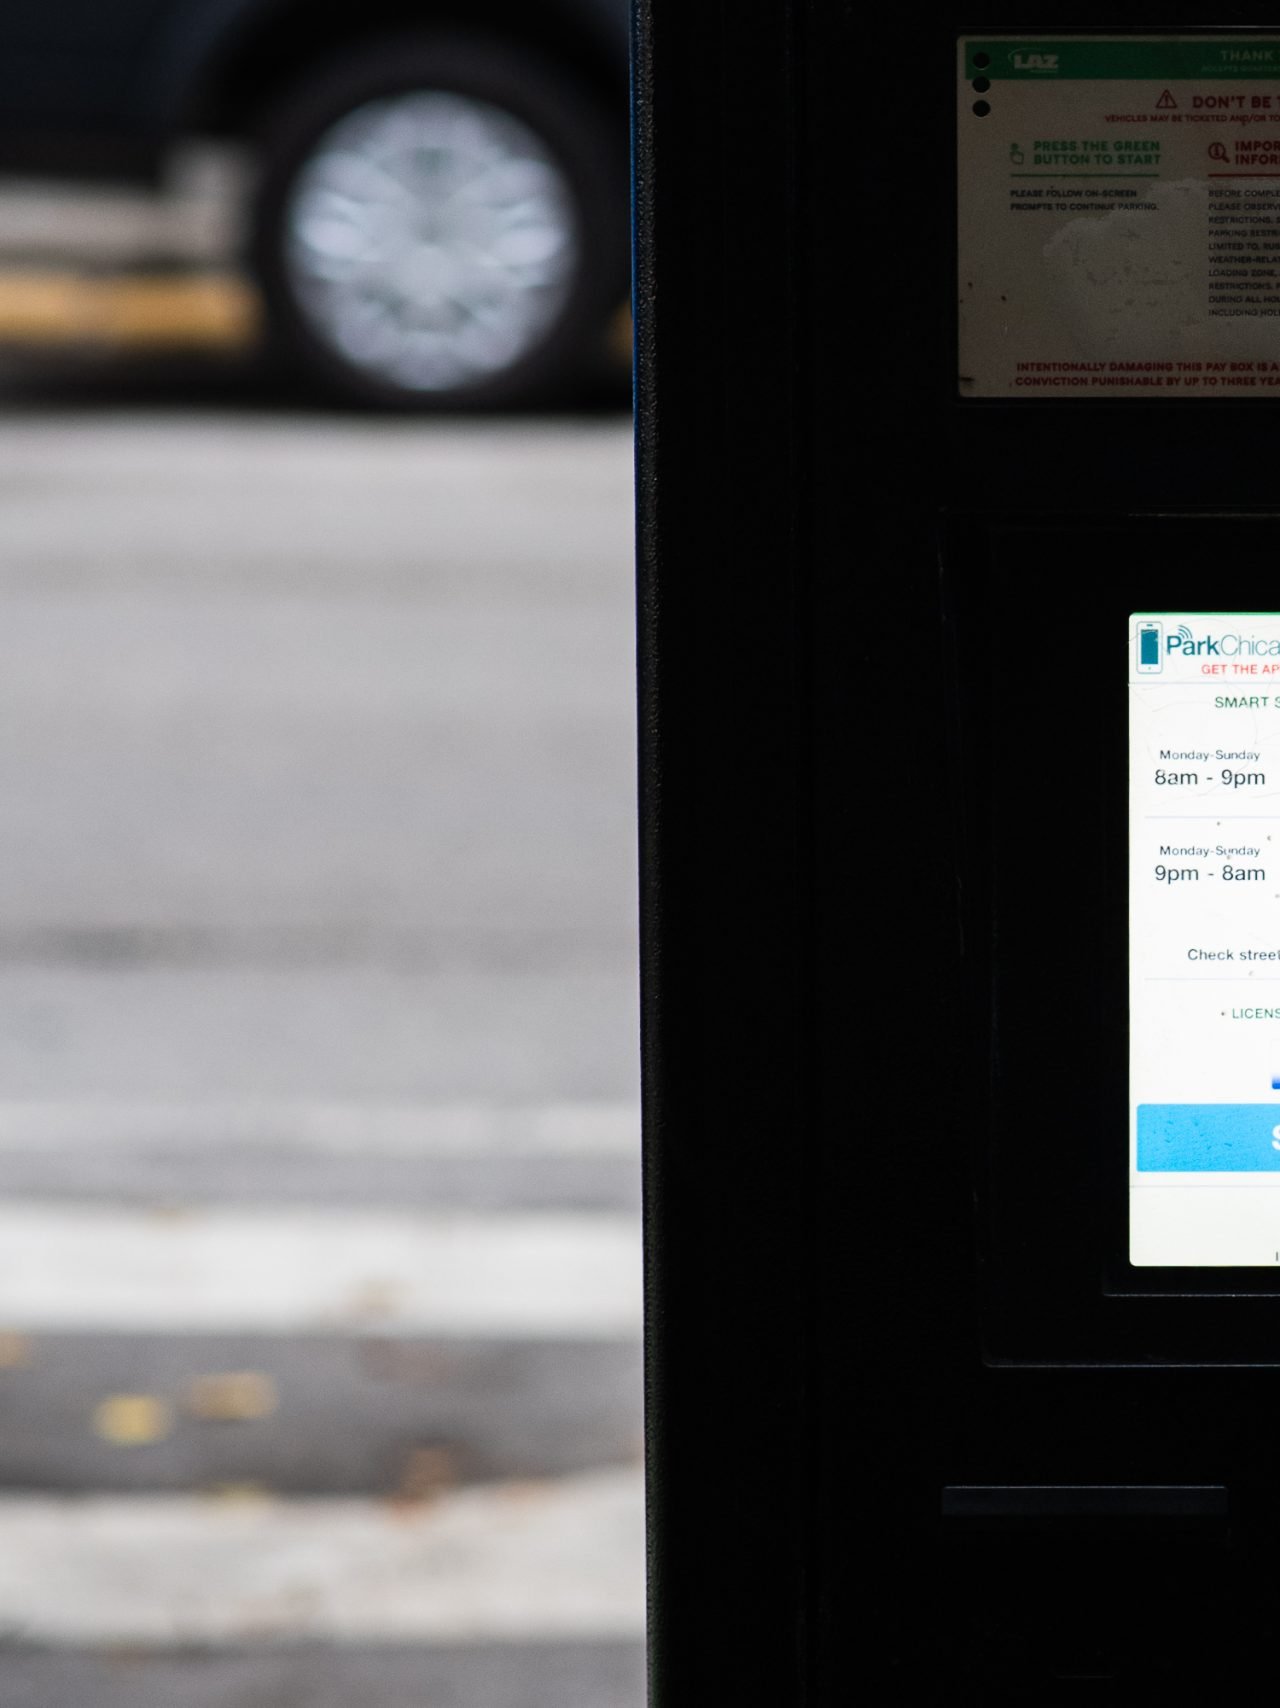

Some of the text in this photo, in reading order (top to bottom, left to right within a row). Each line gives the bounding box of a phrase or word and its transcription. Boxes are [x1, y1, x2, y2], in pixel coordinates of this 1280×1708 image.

[1014, 54, 1058, 69] LAZ
[1220, 50, 1273, 62] THANK
[1193, 96, 1246, 108] DON'T
[1251, 96, 1271, 108] BE
[1034, 141, 1160, 151] PRESS THE GREEN
[1034, 154, 1160, 165] BUTTON TO START
[1010, 203, 1052, 211] PROMPTS
[1056, 203, 1066, 211] TO
[1070, 203, 1114, 211] CONTINUE
[1017, 363, 1106, 371] INTENTIONALLY
[1109, 363, 1173, 371] DAMAGING
[1176, 363, 1201, 371] THIS
[1206, 363, 1227, 371] PAY
[1230, 363, 1254, 371] BOX
[1257, 363, 1267, 371] IS
[1270, 363, 1279, 371] A
[1015, 377, 1088, 386] CONVICTION
[1092, 377, 1162, 386] PUNISHABLE
[1166, 377, 1180, 386] BY
[1184, 377, 1199, 386] UP
[1203, 377, 1217, 386] TO
[1221, 377, 1256, 386] THREE
[1201, 664, 1227, 674] GET
[1232, 664, 1257, 674] THE
[1215, 696, 1269, 708] SMART
[1159, 750, 1260, 762] Monday-Sunday
[1154, 770, 1199, 785] 8am
[1221, 770, 1265, 789] 9pm
[1159, 846, 1260, 857] Monday-Sunday
[1154, 865, 1199, 884] 9pm
[1222, 865, 1266, 881] 8am
[1188, 948, 1234, 961] Check
[1239, 949, 1280, 961] street
